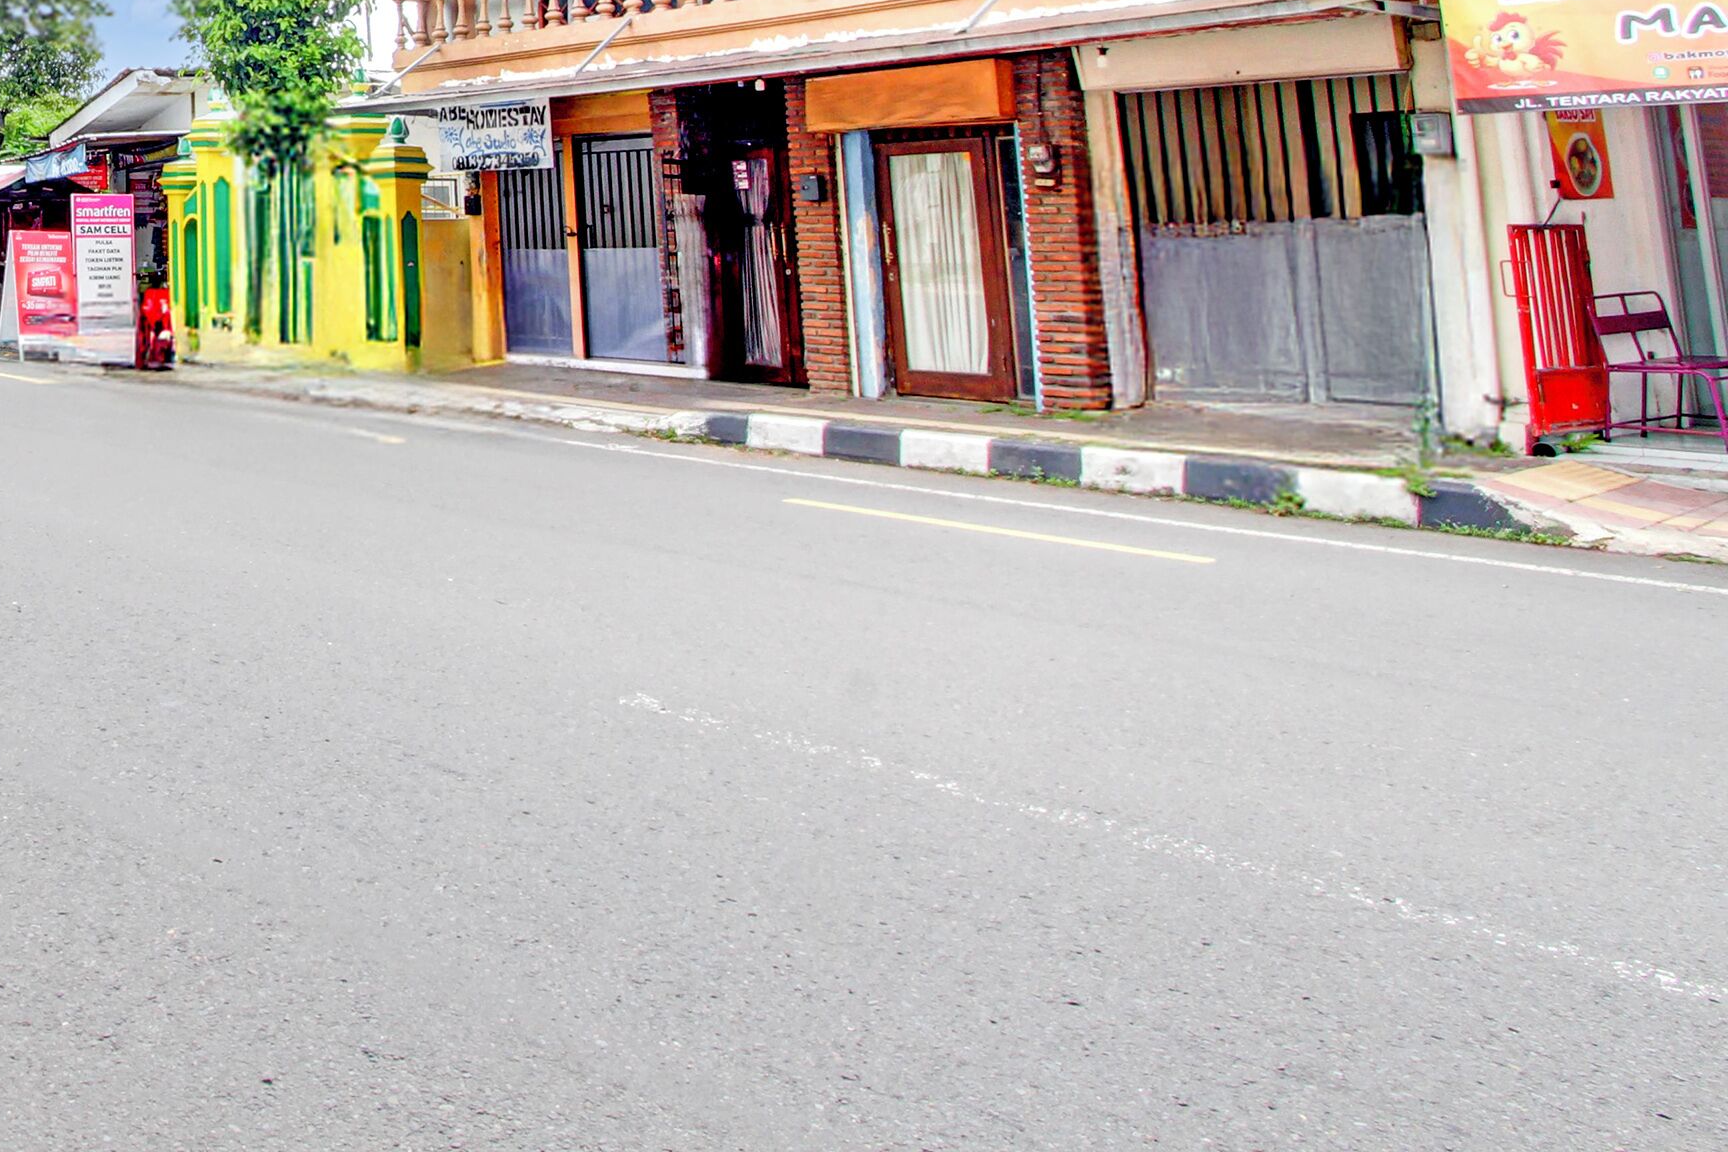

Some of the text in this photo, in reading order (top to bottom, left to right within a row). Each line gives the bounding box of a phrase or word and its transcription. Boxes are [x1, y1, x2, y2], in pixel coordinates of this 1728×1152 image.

[1514, 97, 1542, 109] JL.
[1545, 90, 1641, 108] TENTARA
[466, 105, 546, 130] HOMESTAY
[75, 204, 131, 217] smartfren
[80, 226, 128, 234] SAM CELL
